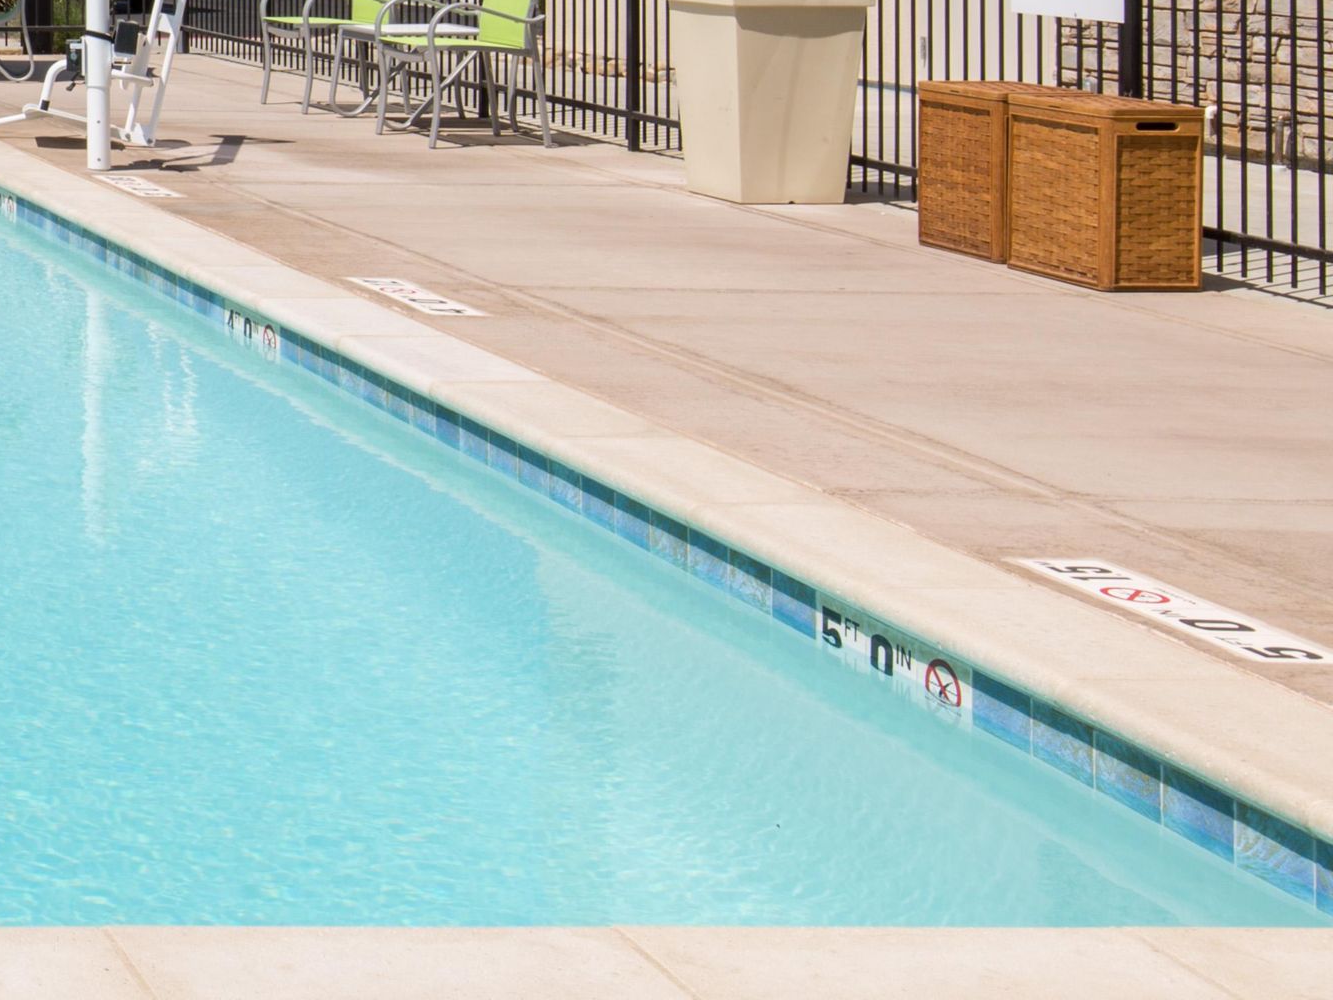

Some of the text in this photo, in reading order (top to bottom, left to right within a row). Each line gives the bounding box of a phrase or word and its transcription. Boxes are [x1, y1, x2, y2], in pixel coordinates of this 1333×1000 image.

[1178, 618, 1256, 632] 0
[822, 605, 911, 677] 5 FT 0 IN
[1241, 647, 1324, 660] 5
